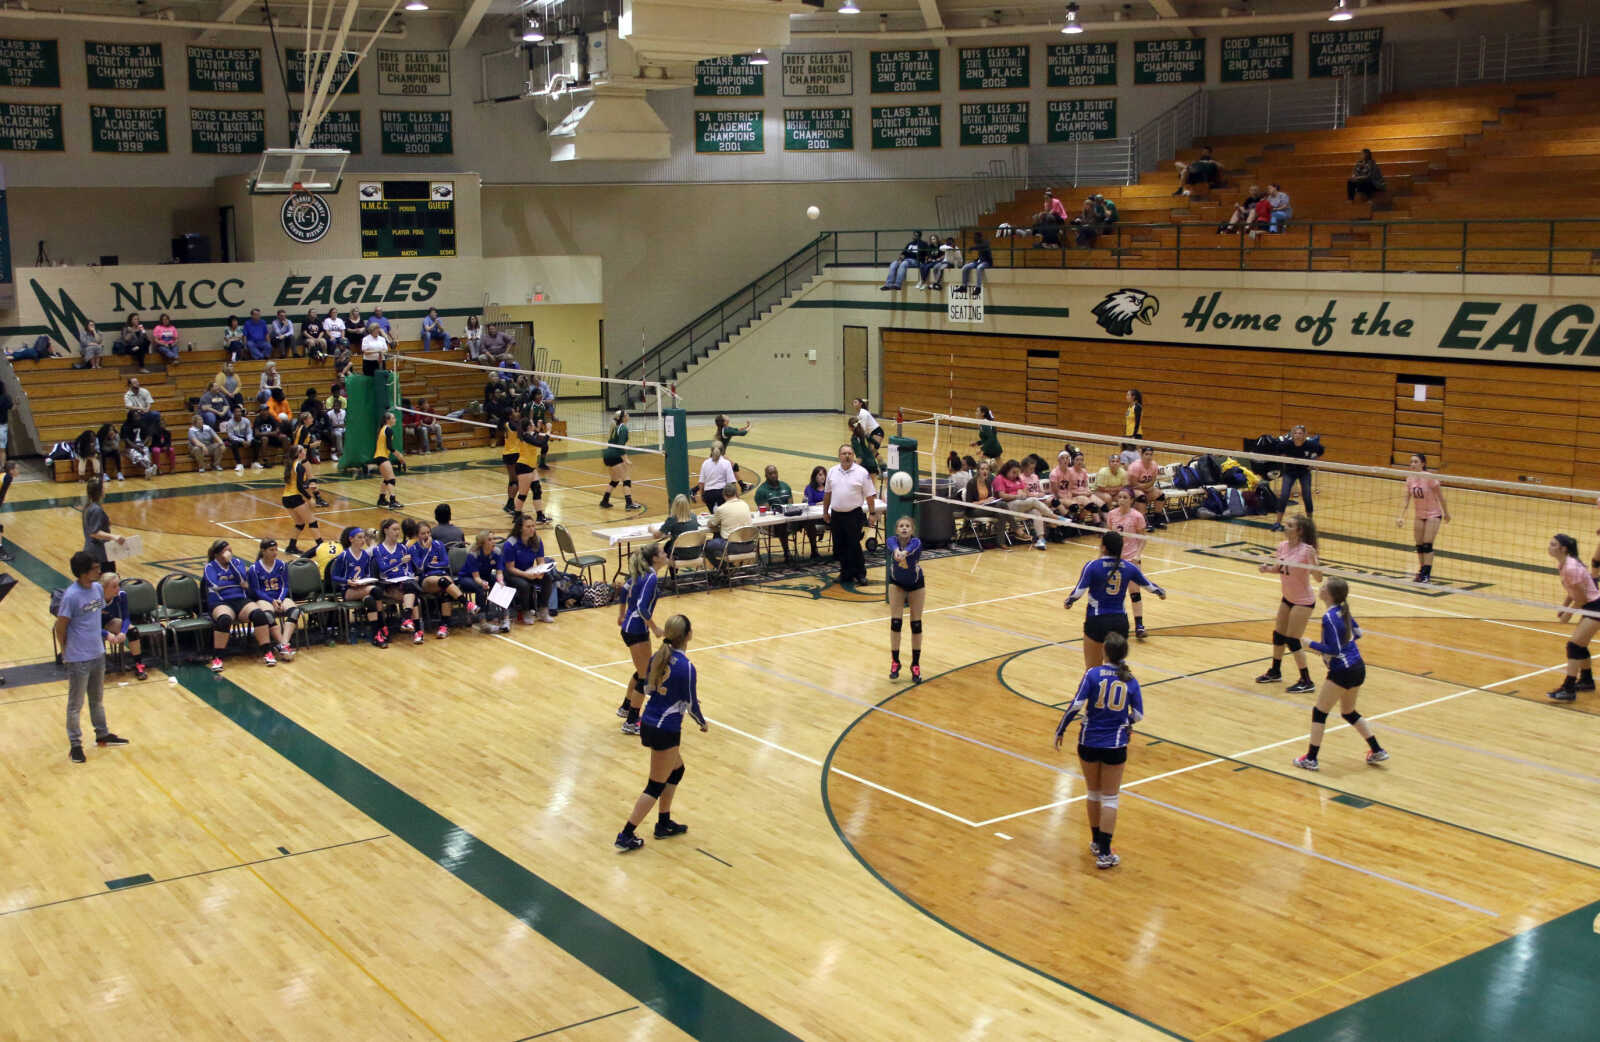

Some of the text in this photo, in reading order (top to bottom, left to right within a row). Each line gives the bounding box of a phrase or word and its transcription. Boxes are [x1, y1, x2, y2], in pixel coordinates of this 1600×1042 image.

[1225, 36, 1289, 48] COED SMALL
[1312, 34, 1336, 44] CLASS
[96, 45, 151, 56] CLASS 3A
[1055, 44, 1108, 56] CLASS 3A
[1148, 42, 1179, 52] CLASS
[1320, 42, 1370, 54] ACADEMIC
[188, 48, 260, 60] BOYS CLASS 3A
[405, 52, 430, 62] CLASS
[880, 50, 929, 62] CLASS 3A
[962, 47, 1026, 59] BOYS CLASS 3A
[1136, 50, 1201, 62] DISTRICT FOOTBALL
[88, 56, 121, 66] DISTRICT
[704, 56, 734, 66] CLASS
[786, 54, 848, 65] BOYS CLASS 3A
[1048, 54, 1116, 65] DISTRICT FOOTBALL
[1228, 59, 1283, 70] 2ND PLACE
[196, 60, 230, 70] DISTRICT
[784, 64, 850, 74] STATE BASKETBALL
[876, 62, 935, 72] STATE FOOTBALL
[1144, 62, 1194, 72] CHAMPIONS
[96, 67, 154, 78] CHAMPIONS
[196, 70, 255, 80] CHAMPIONS
[696, 65, 762, 76] DISTRICT FOOTBALL
[966, 68, 1023, 79] 2ND PLACE
[1054, 65, 1109, 76] CHAMPIONS
[387, 73, 440, 84] CHAMPIONS
[704, 76, 754, 86] CHAMPIONS
[790, 74, 846, 84] CHAMPIONS
[878, 71, 932, 82] 2ND PLACE
[1069, 76, 1096, 86] 2003
[114, 79, 139, 88] 1997
[894, 82, 917, 92] 2001
[982, 78, 1008, 88] 2002
[402, 84, 428, 94] 2000
[716, 86, 742, 95] 2000
[806, 85, 830, 94] 2001
[10, 105, 57, 117] DISTRICT
[962, 103, 1026, 114] BOYS CLASS 3A
[1050, 100, 1112, 112] CLASS DISTRICT
[94, 107, 162, 119] 3A DISTRICT
[192, 110, 264, 121] BOYS CLASS 3A
[340, 112, 350, 122] 3A
[382, 112, 402, 122] BOYS
[408, 112, 433, 122] CLASS
[699, 112, 760, 122] 3A DISTRICT
[786, 110, 850, 120] BOYS CLASS 3A
[881, 107, 930, 118] CLASS 3A
[1059, 111, 1105, 122] ACADEMIC
[105, 120, 154, 130] ACADEMIC
[708, 122, 752, 132] ACADEMIC
[786, 120, 810, 130] DISTRICT
[872, 117, 940, 128] DISTRICT FOOTBALL
[1056, 121, 1108, 132] CHAMPIONS
[881, 128, 932, 138] CHAMPIONS
[969, 124, 1021, 134] CHAMPIONS
[100, 130, 160, 141] CHAMPIONS
[200, 131, 257, 142] CHAMPIONS
[390, 132, 444, 143] CHAMPIONS
[704, 132, 756, 142] CHAMPIONS
[792, 130, 845, 140] CHAMPIONS
[982, 134, 1008, 144] 2002
[13, 140, 38, 150] 1997
[719, 142, 741, 151] 2001
[808, 140, 830, 150] 2001
[895, 137, 918, 146] 2001
[118, 142, 144, 152] 1998
[404, 144, 430, 153] 2000
[110, 272, 442, 312] NMCC EAGLES
[950, 306, 982, 320] SEATING
[1181, 291, 1600, 358] Home of the EAG
[132, 428, 142, 441] 7
[1106, 570, 1122, 596] 9
[1094, 678, 1128, 712] 10
